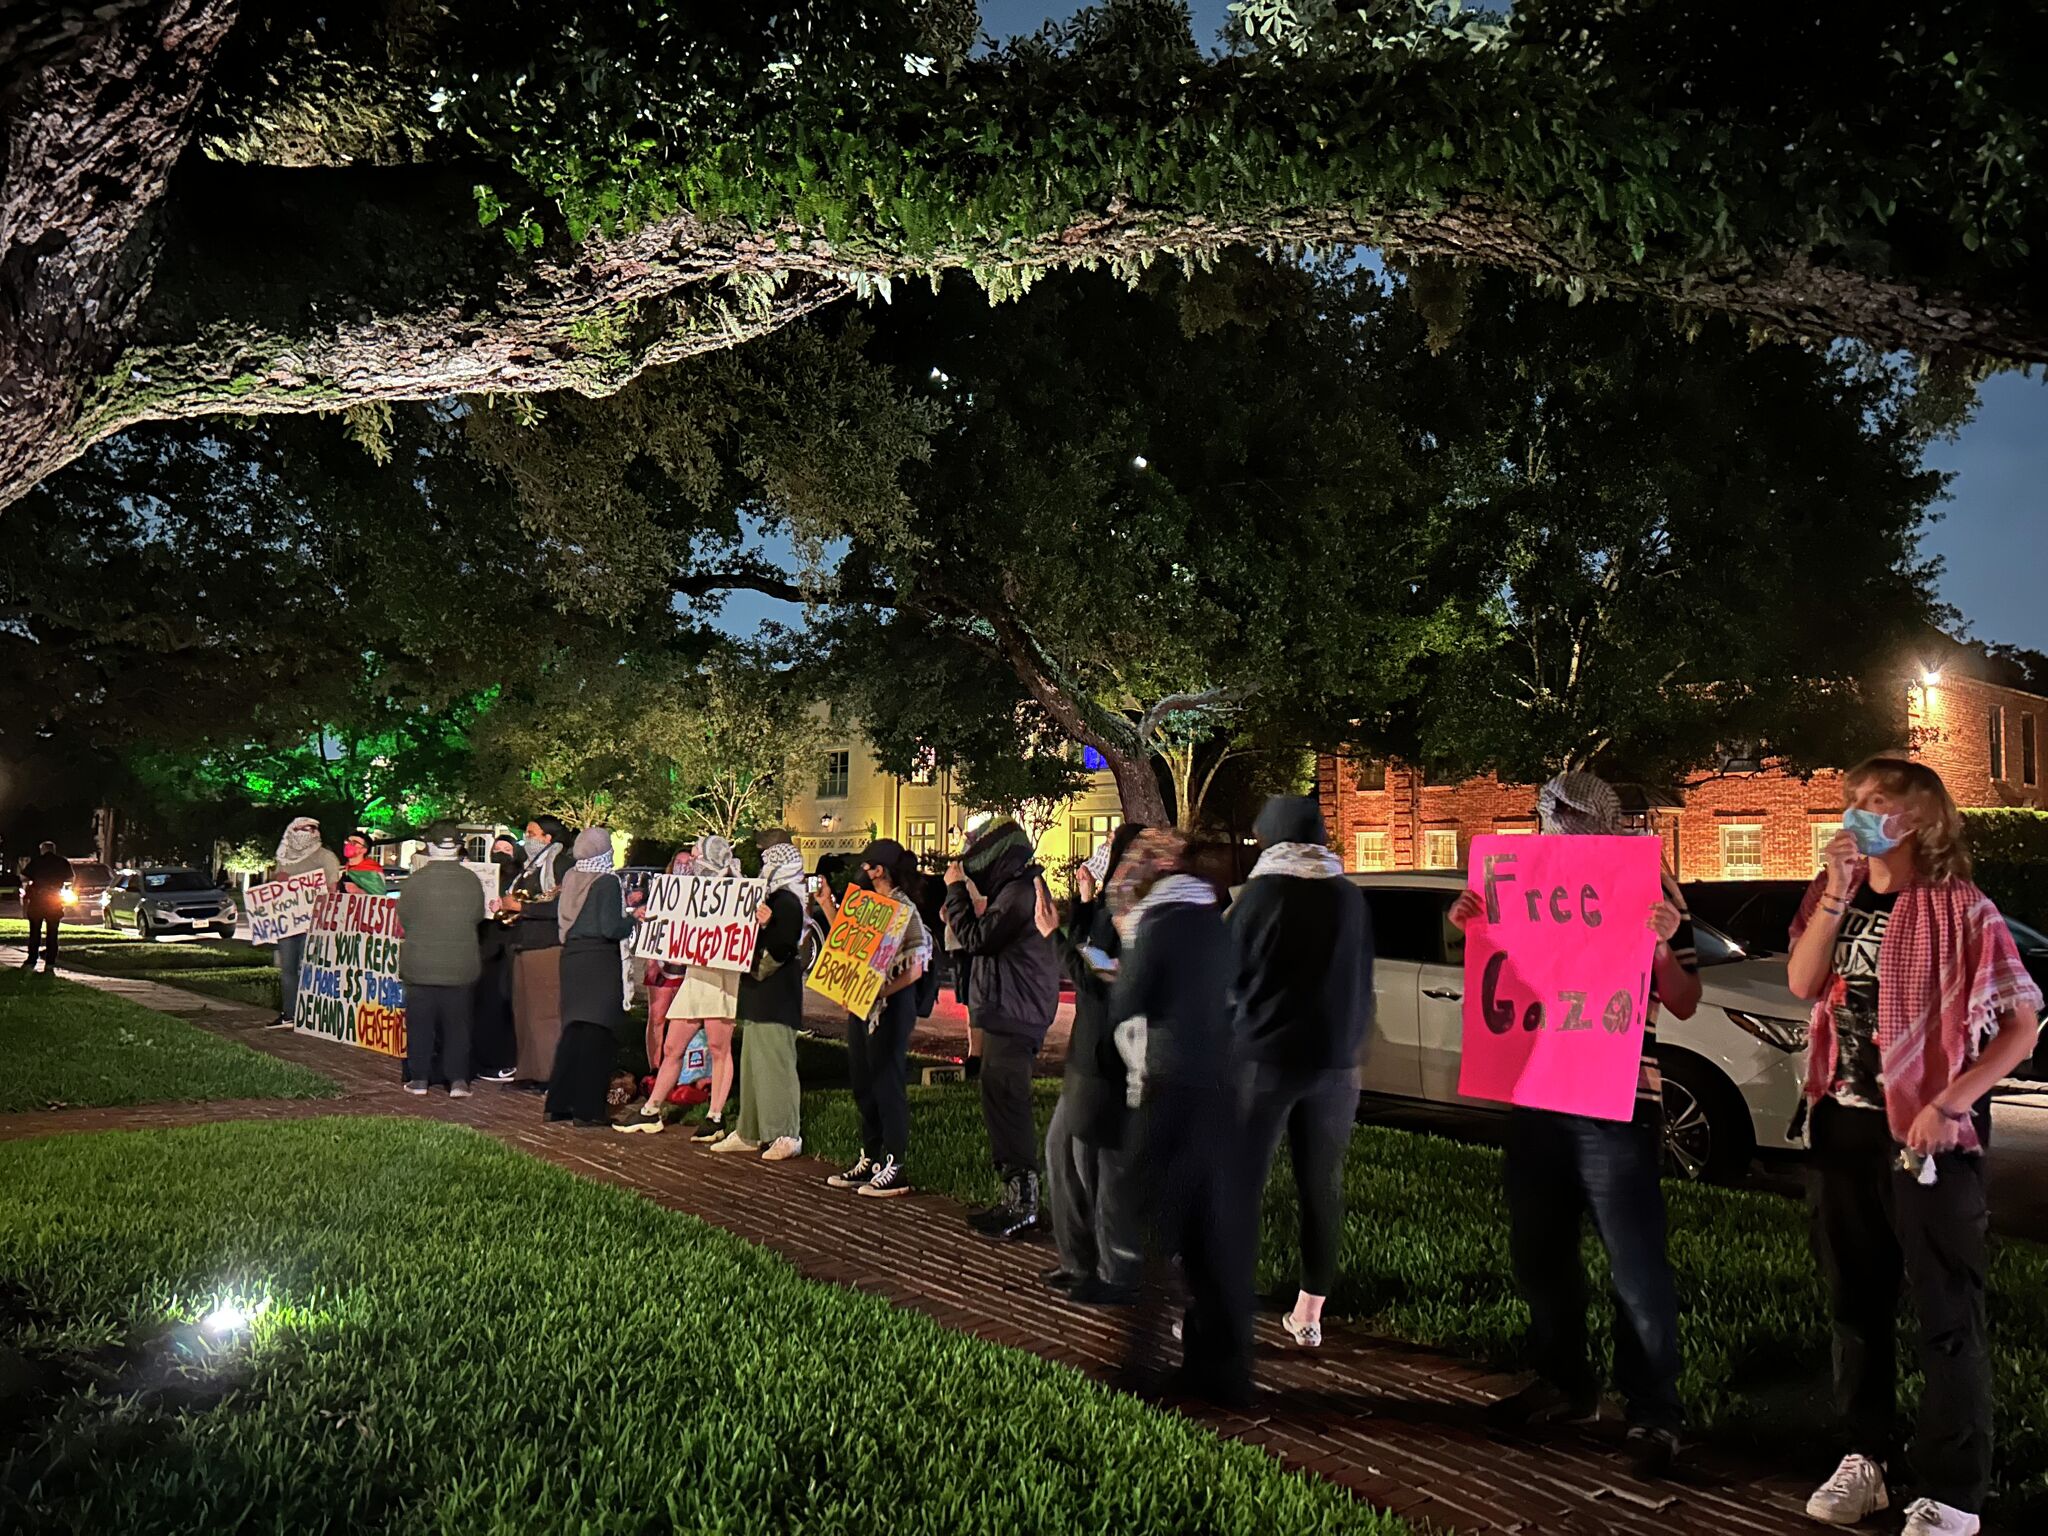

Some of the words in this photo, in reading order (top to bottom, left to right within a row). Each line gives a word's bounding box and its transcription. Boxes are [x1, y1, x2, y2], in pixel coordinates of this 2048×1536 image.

[245, 884, 284, 905] TED
[288, 873, 325, 893] CRUZ
[649, 875, 680, 911] NO
[685, 877, 734, 919] REST
[734, 881, 763, 922] FOR
[1483, 853, 1602, 928] Free
[309, 893, 342, 933] FREE
[306, 934, 331, 967] CALL
[335, 931, 361, 968] YOUR
[364, 936, 398, 974] REPS
[643, 915, 669, 955] THE
[668, 920, 722, 967] WICKED
[722, 922, 760, 967] TED!
[313, 967, 341, 999] MORE
[343, 966, 363, 1008] $$
[1481, 951, 1646, 1036] Gaza!
[296, 993, 345, 1041] DEMAND
[345, 1004, 357, 1042] A
